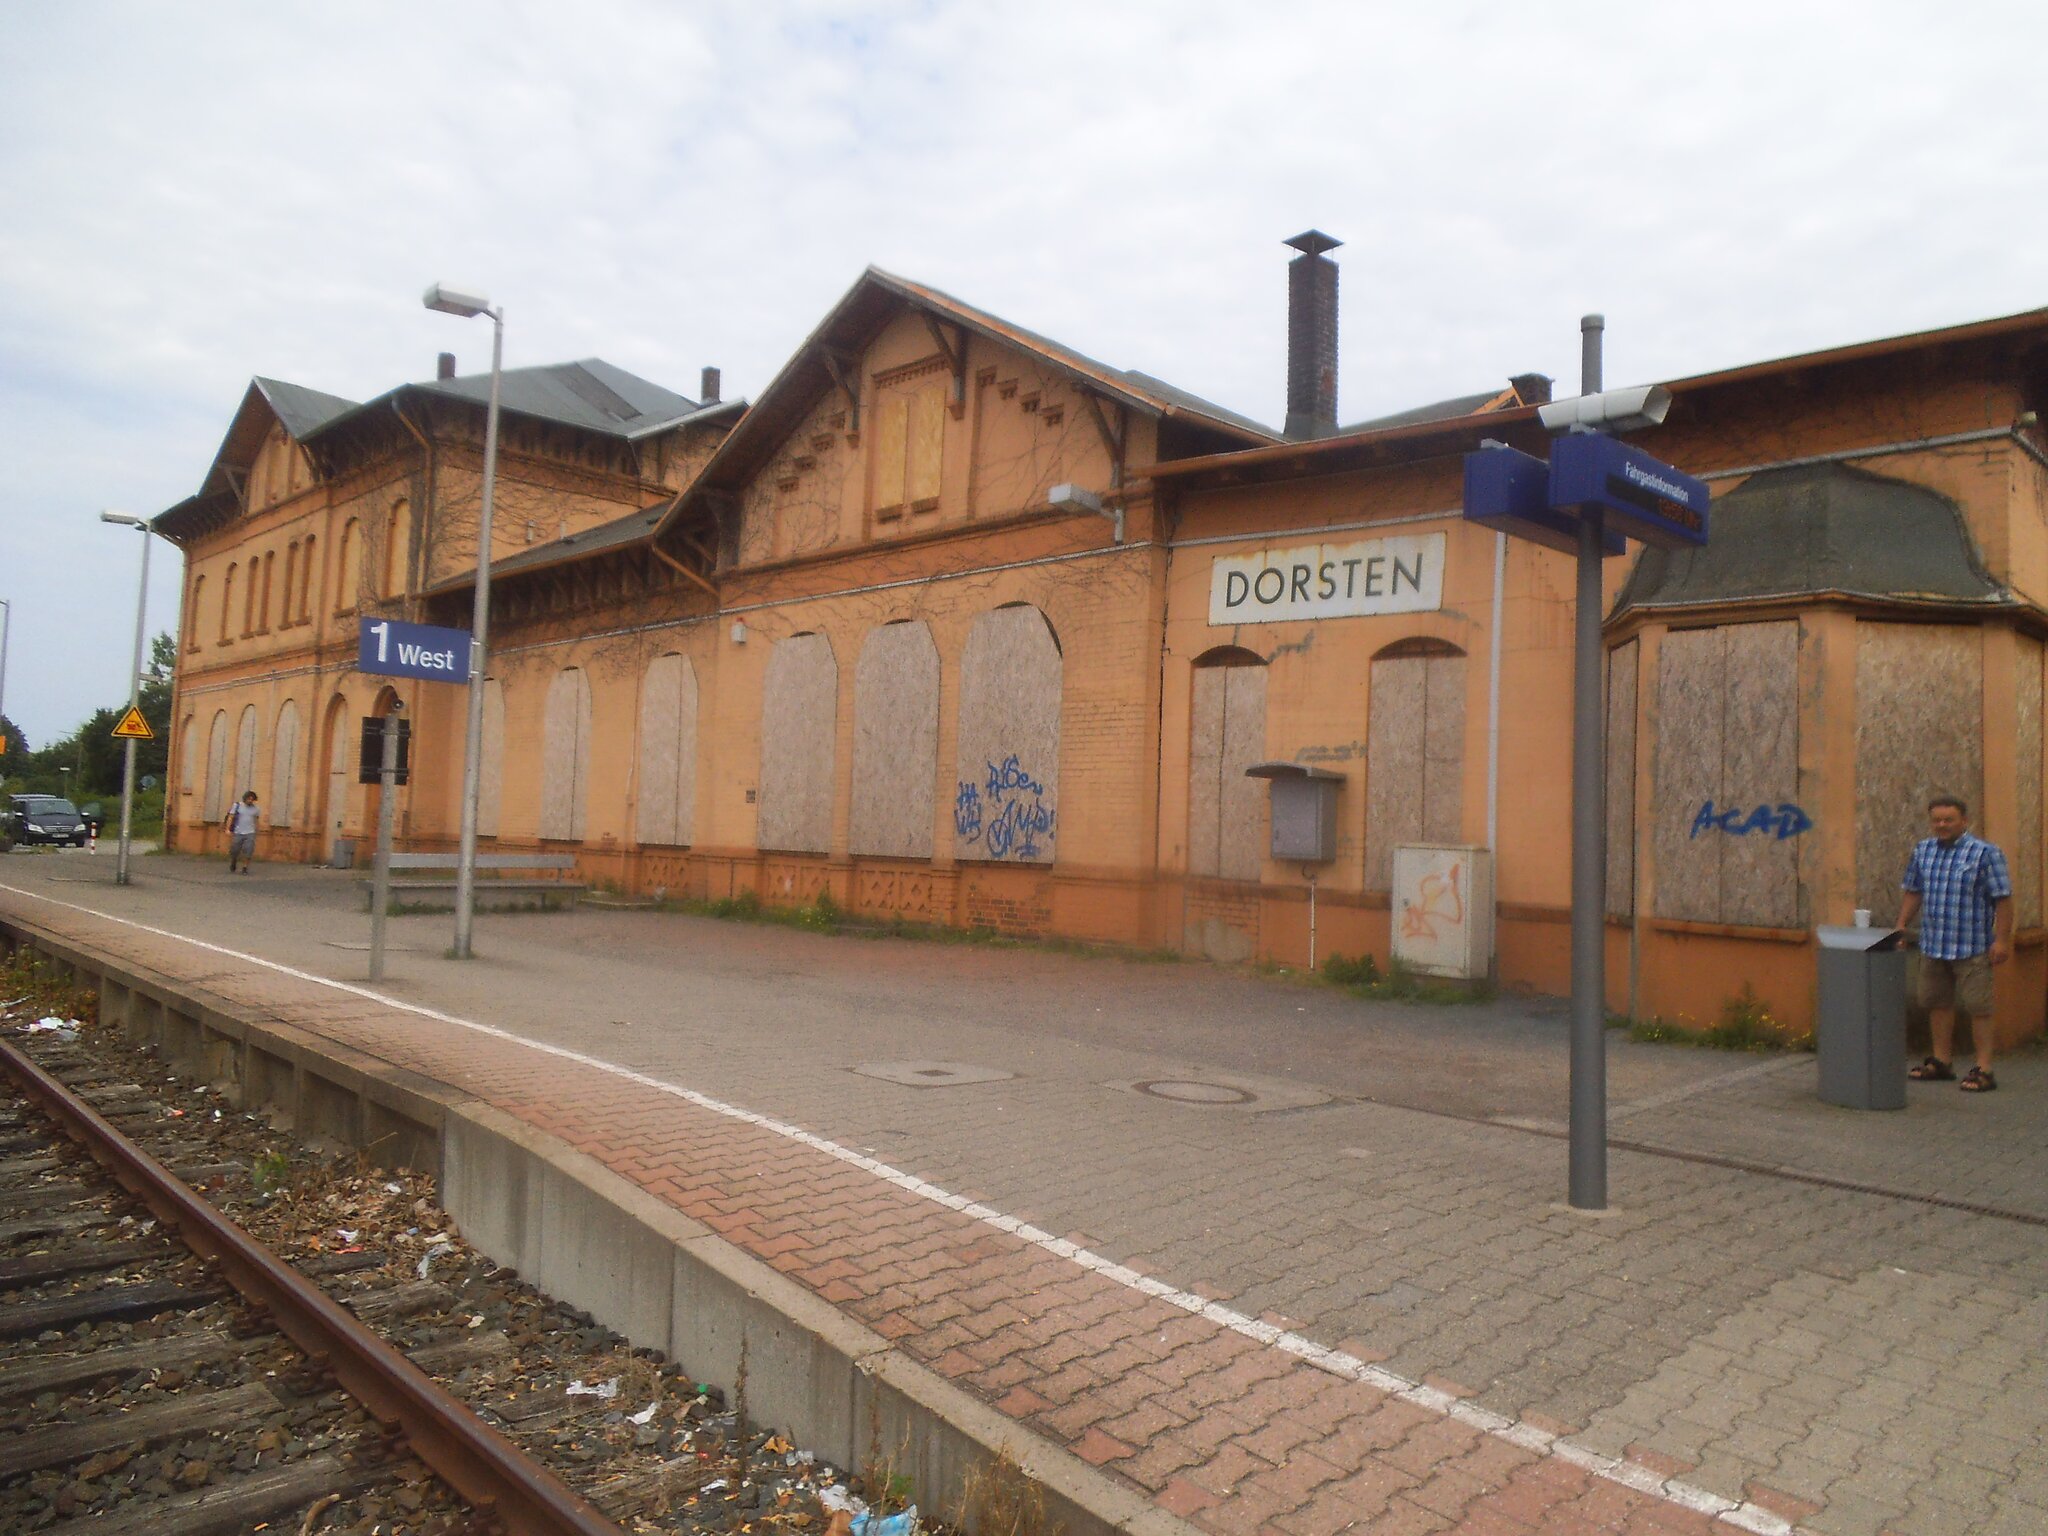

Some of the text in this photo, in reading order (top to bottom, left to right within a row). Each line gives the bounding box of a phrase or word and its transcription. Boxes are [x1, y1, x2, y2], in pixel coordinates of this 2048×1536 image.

[1625, 461, 1689, 503] Fahrgastinformation
[1226, 552, 1424, 608] DORSTEN
[371, 621, 455, 671] 1 West
